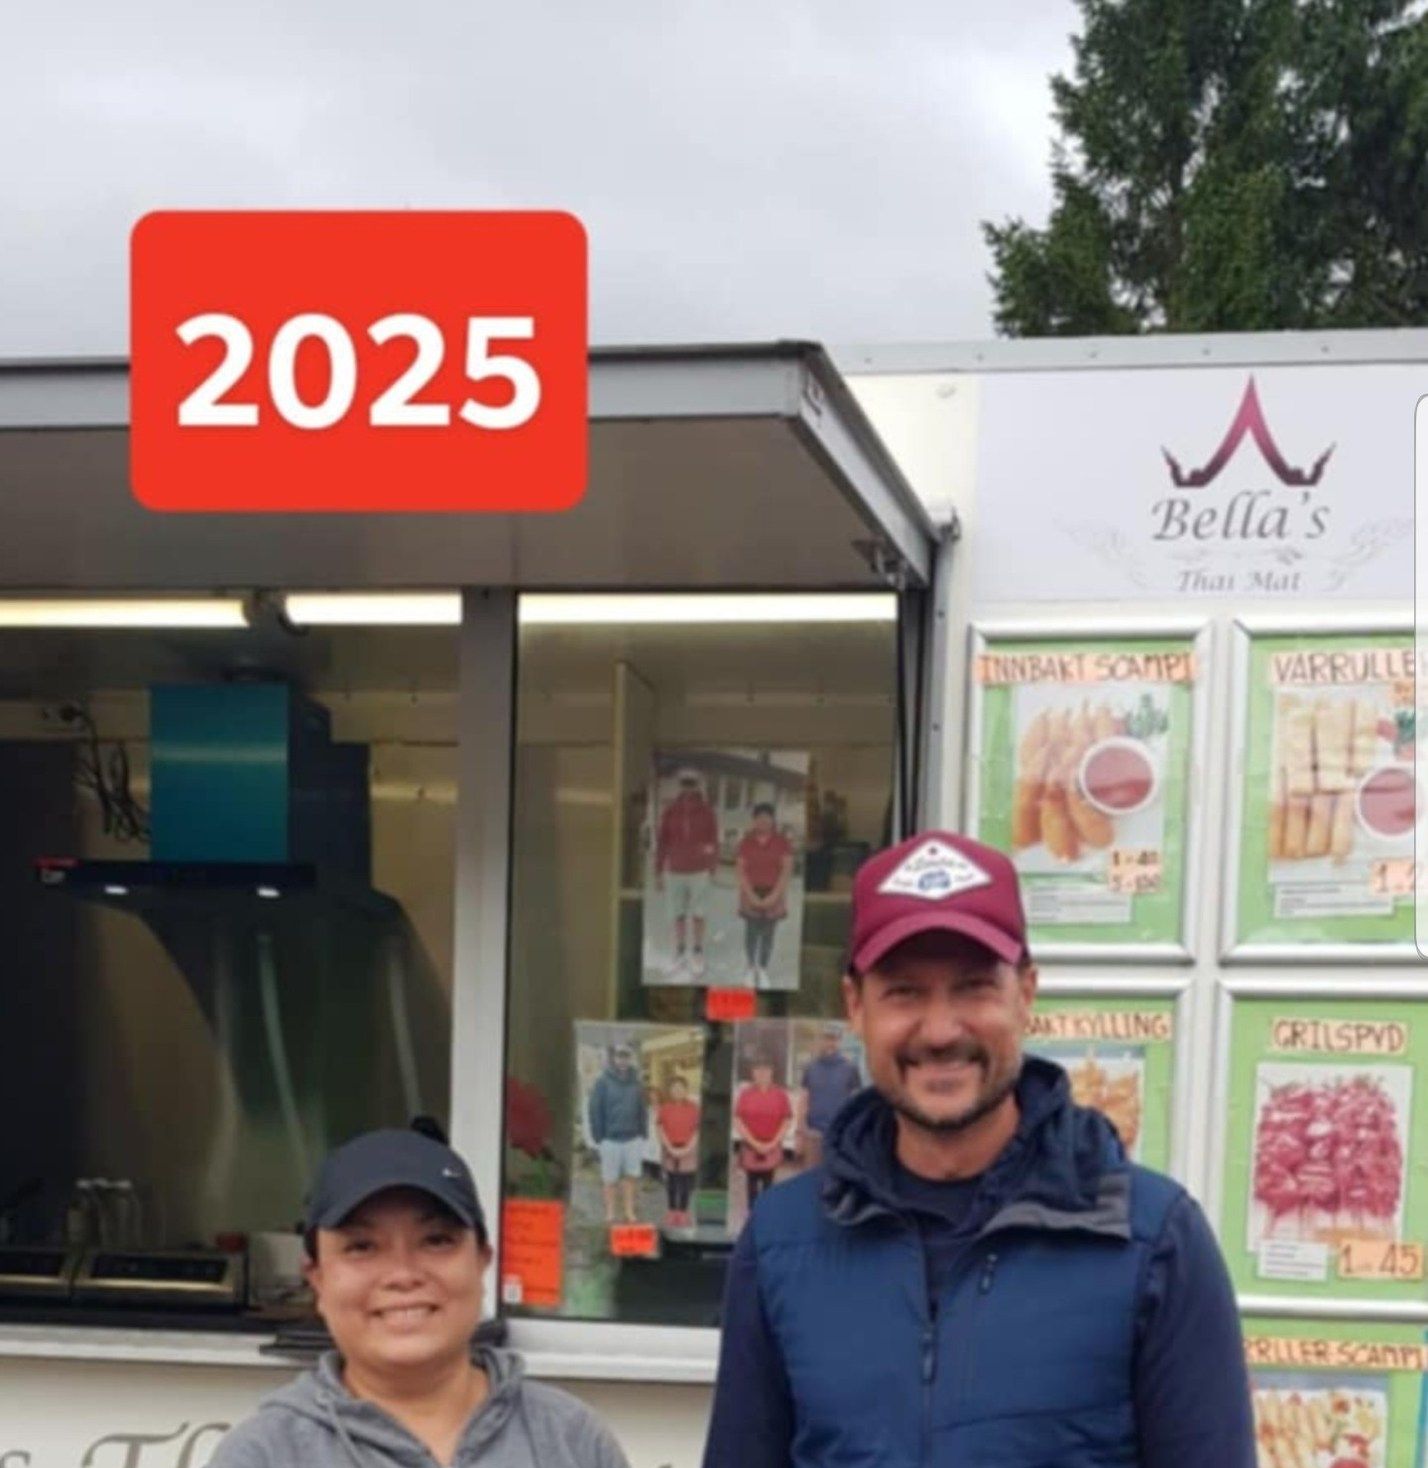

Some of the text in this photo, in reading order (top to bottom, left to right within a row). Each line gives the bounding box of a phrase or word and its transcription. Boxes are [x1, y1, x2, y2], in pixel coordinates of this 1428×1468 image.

[1151, 488, 1332, 541] Bella's
[978, 653, 1086, 683] INNBAKT
[1273, 649, 1416, 683] VARRULLE
[1379, 1243, 1420, 1275] 45
